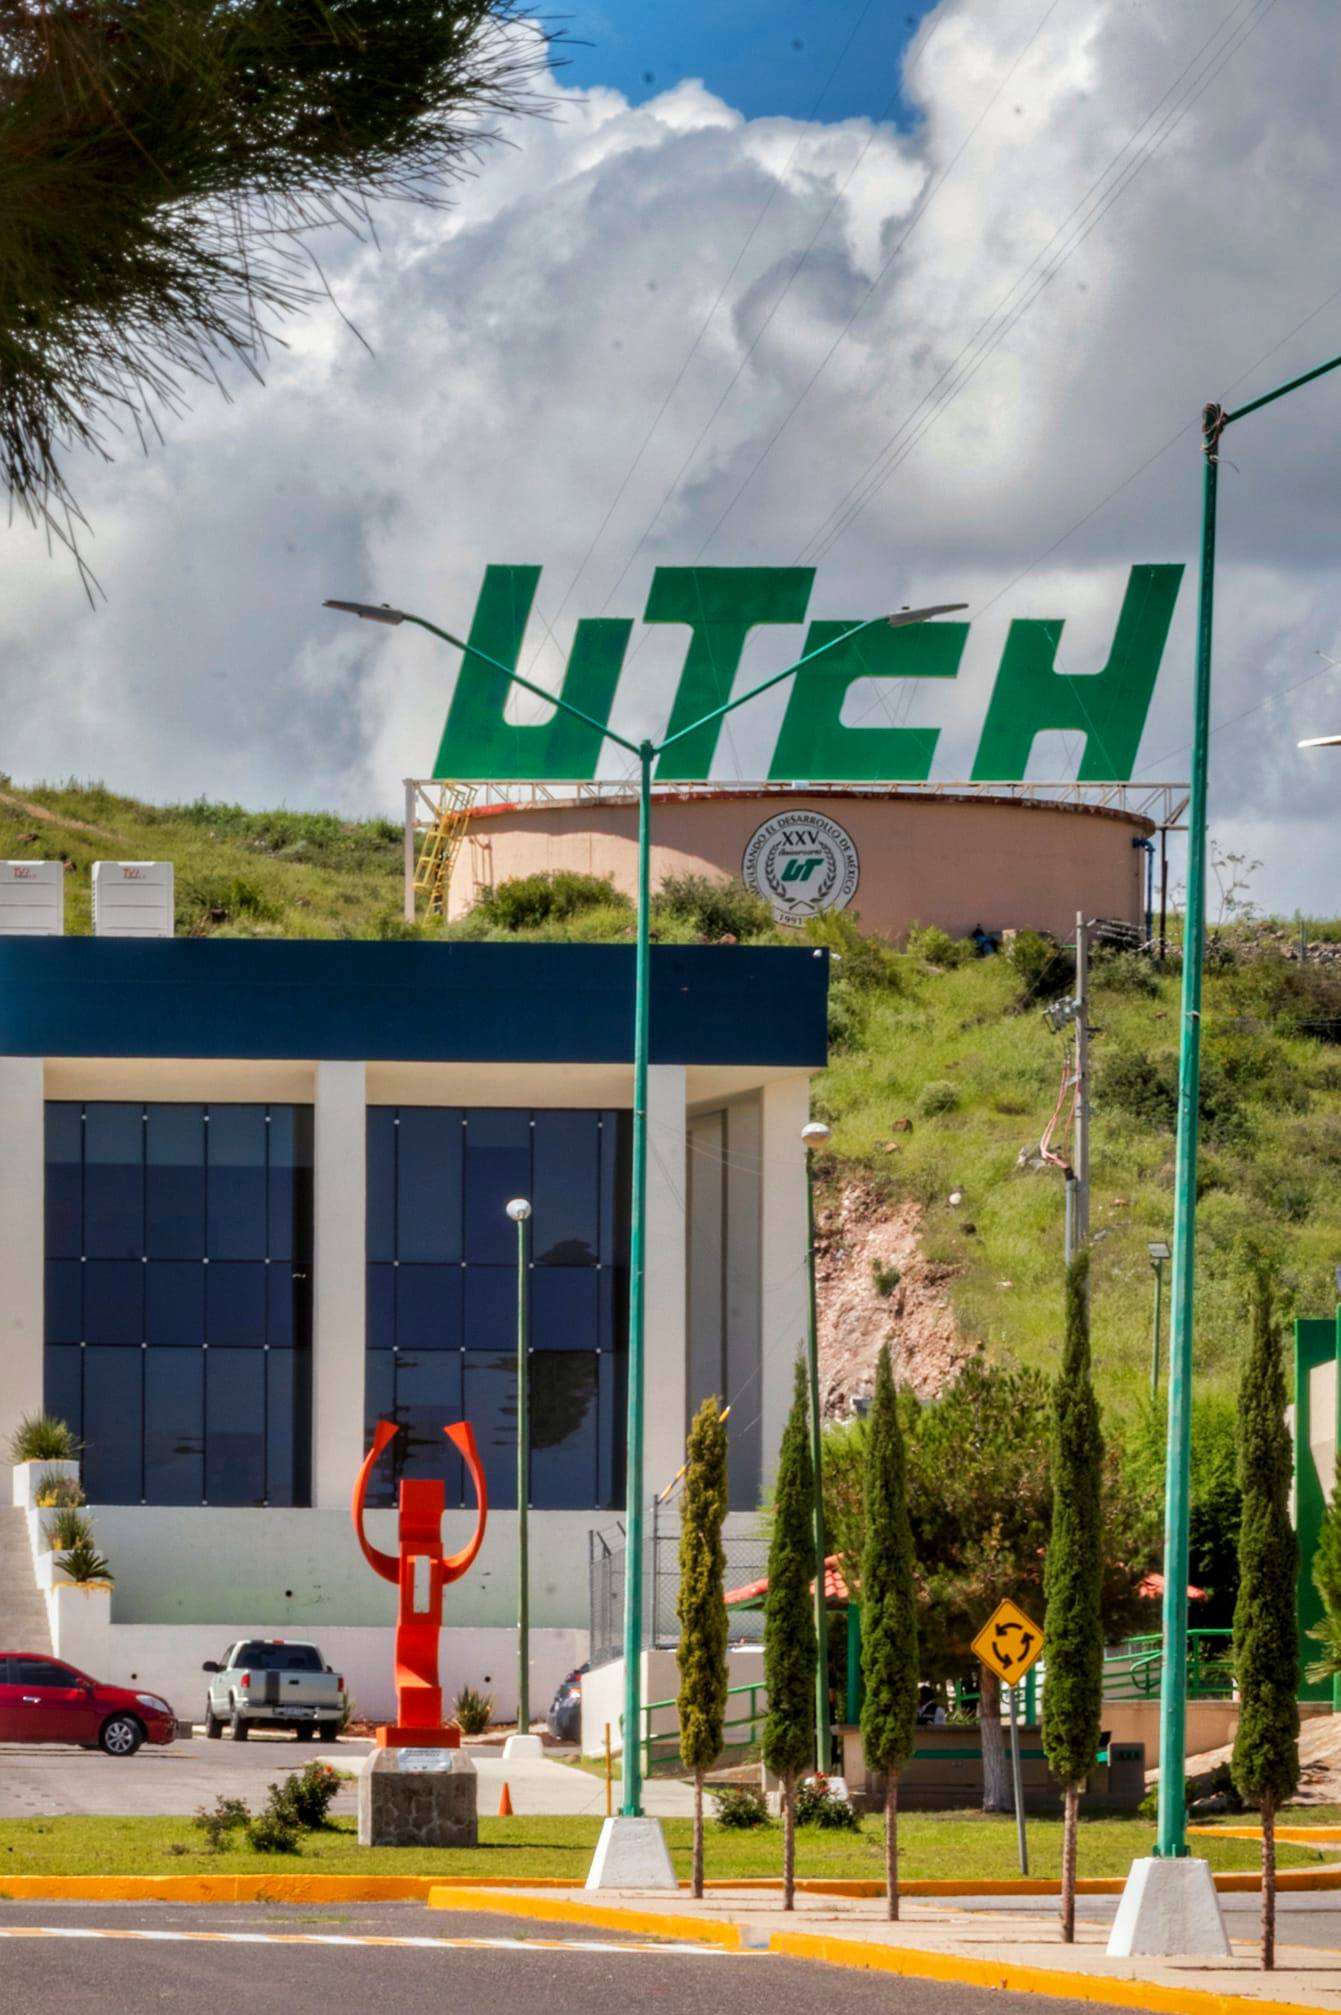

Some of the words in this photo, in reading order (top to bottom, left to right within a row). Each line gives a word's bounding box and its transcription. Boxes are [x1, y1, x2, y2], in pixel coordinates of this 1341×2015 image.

[432, 563, 1186, 782] UTCH
[765, 824, 778, 836] EL
[777, 815, 841, 839] DESARROLLO
[782, 830, 820, 846] XXV
[839, 837, 852, 851] DE
[781, 858, 824, 882] UT
[843, 854, 857, 895] MÉXICO
[778, 914, 803, 925] 1991
